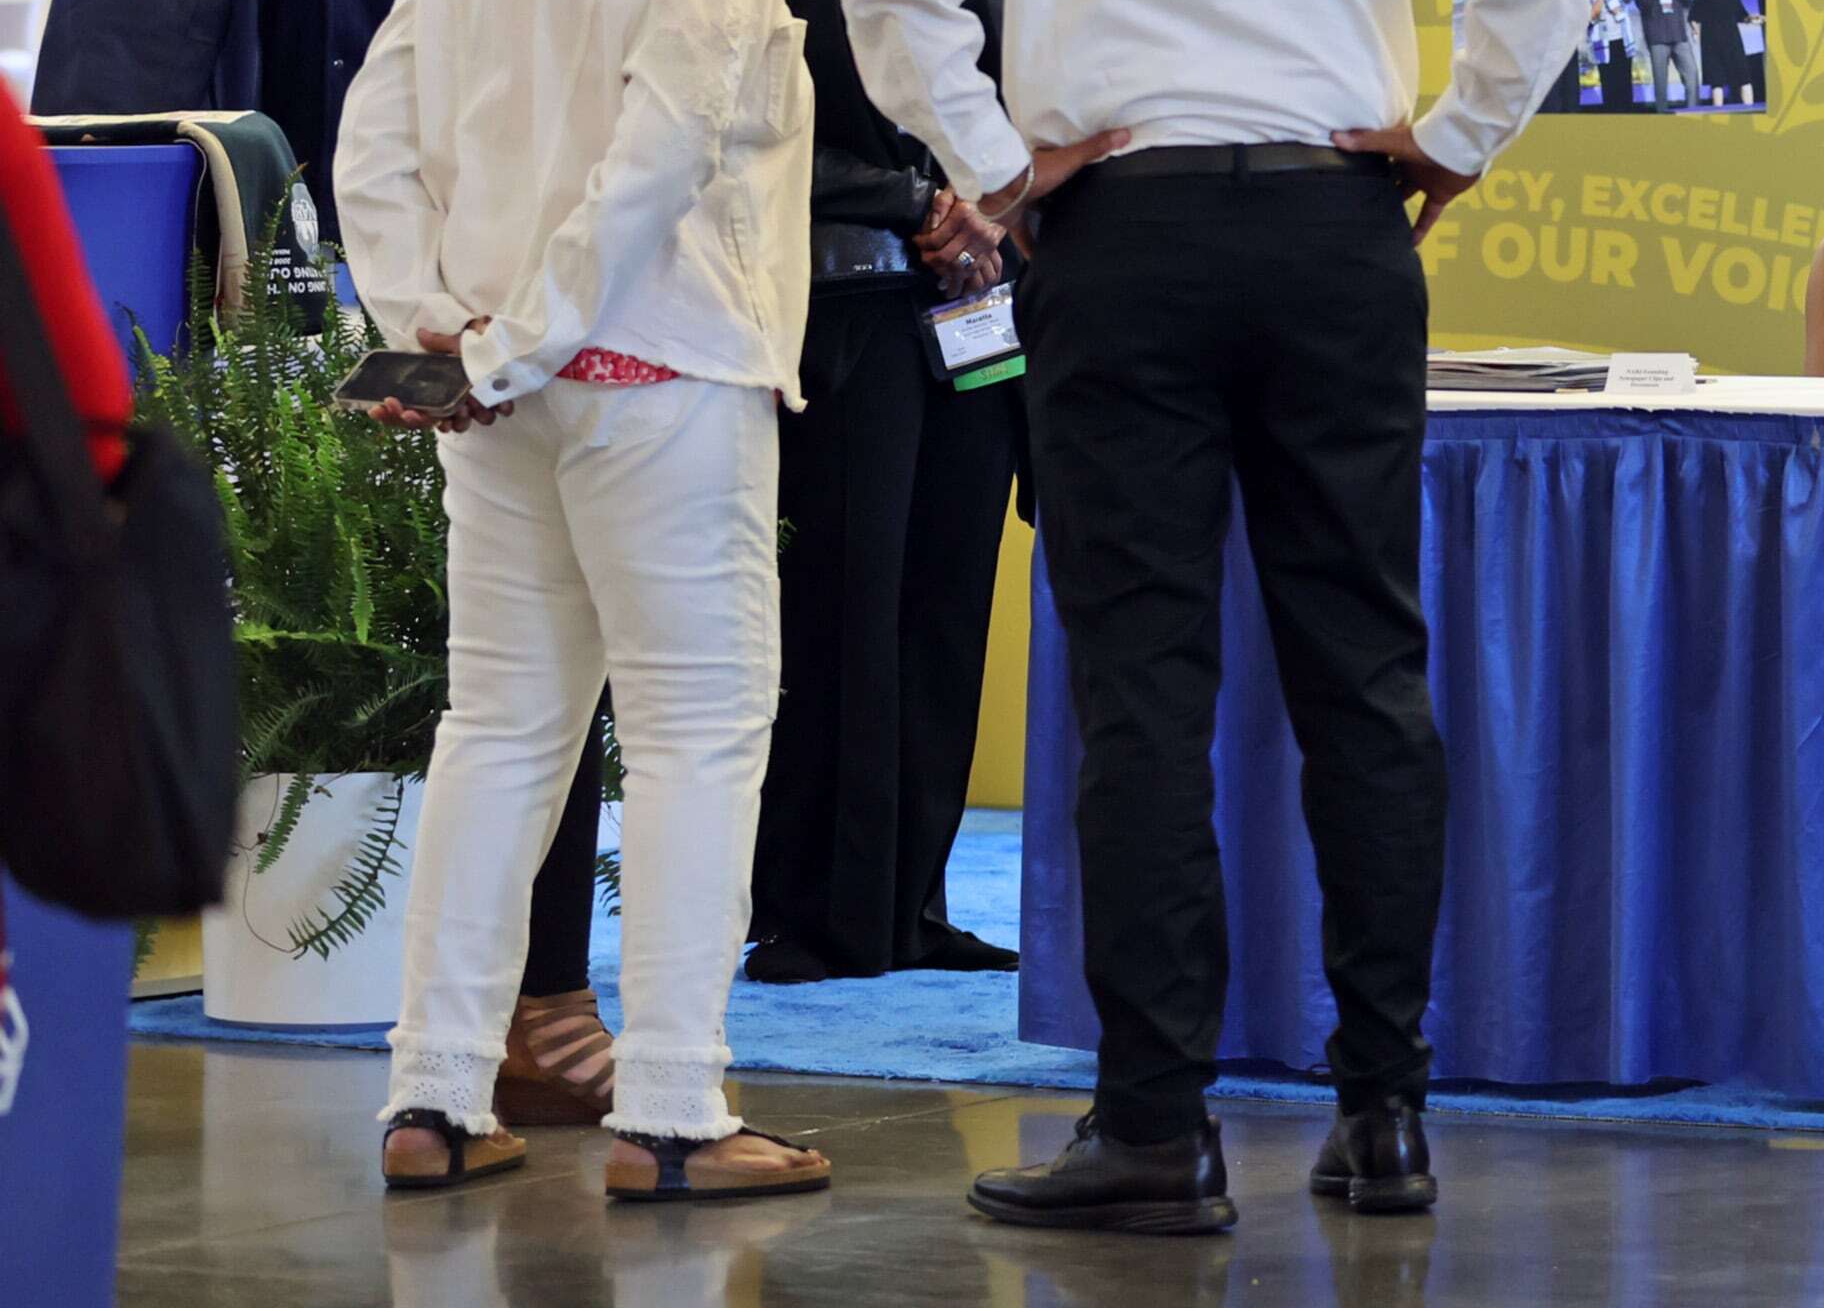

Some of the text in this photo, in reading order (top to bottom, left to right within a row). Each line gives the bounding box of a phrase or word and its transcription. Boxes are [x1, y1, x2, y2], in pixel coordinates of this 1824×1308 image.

[1415, 222, 1808, 313] F OUR VOI
